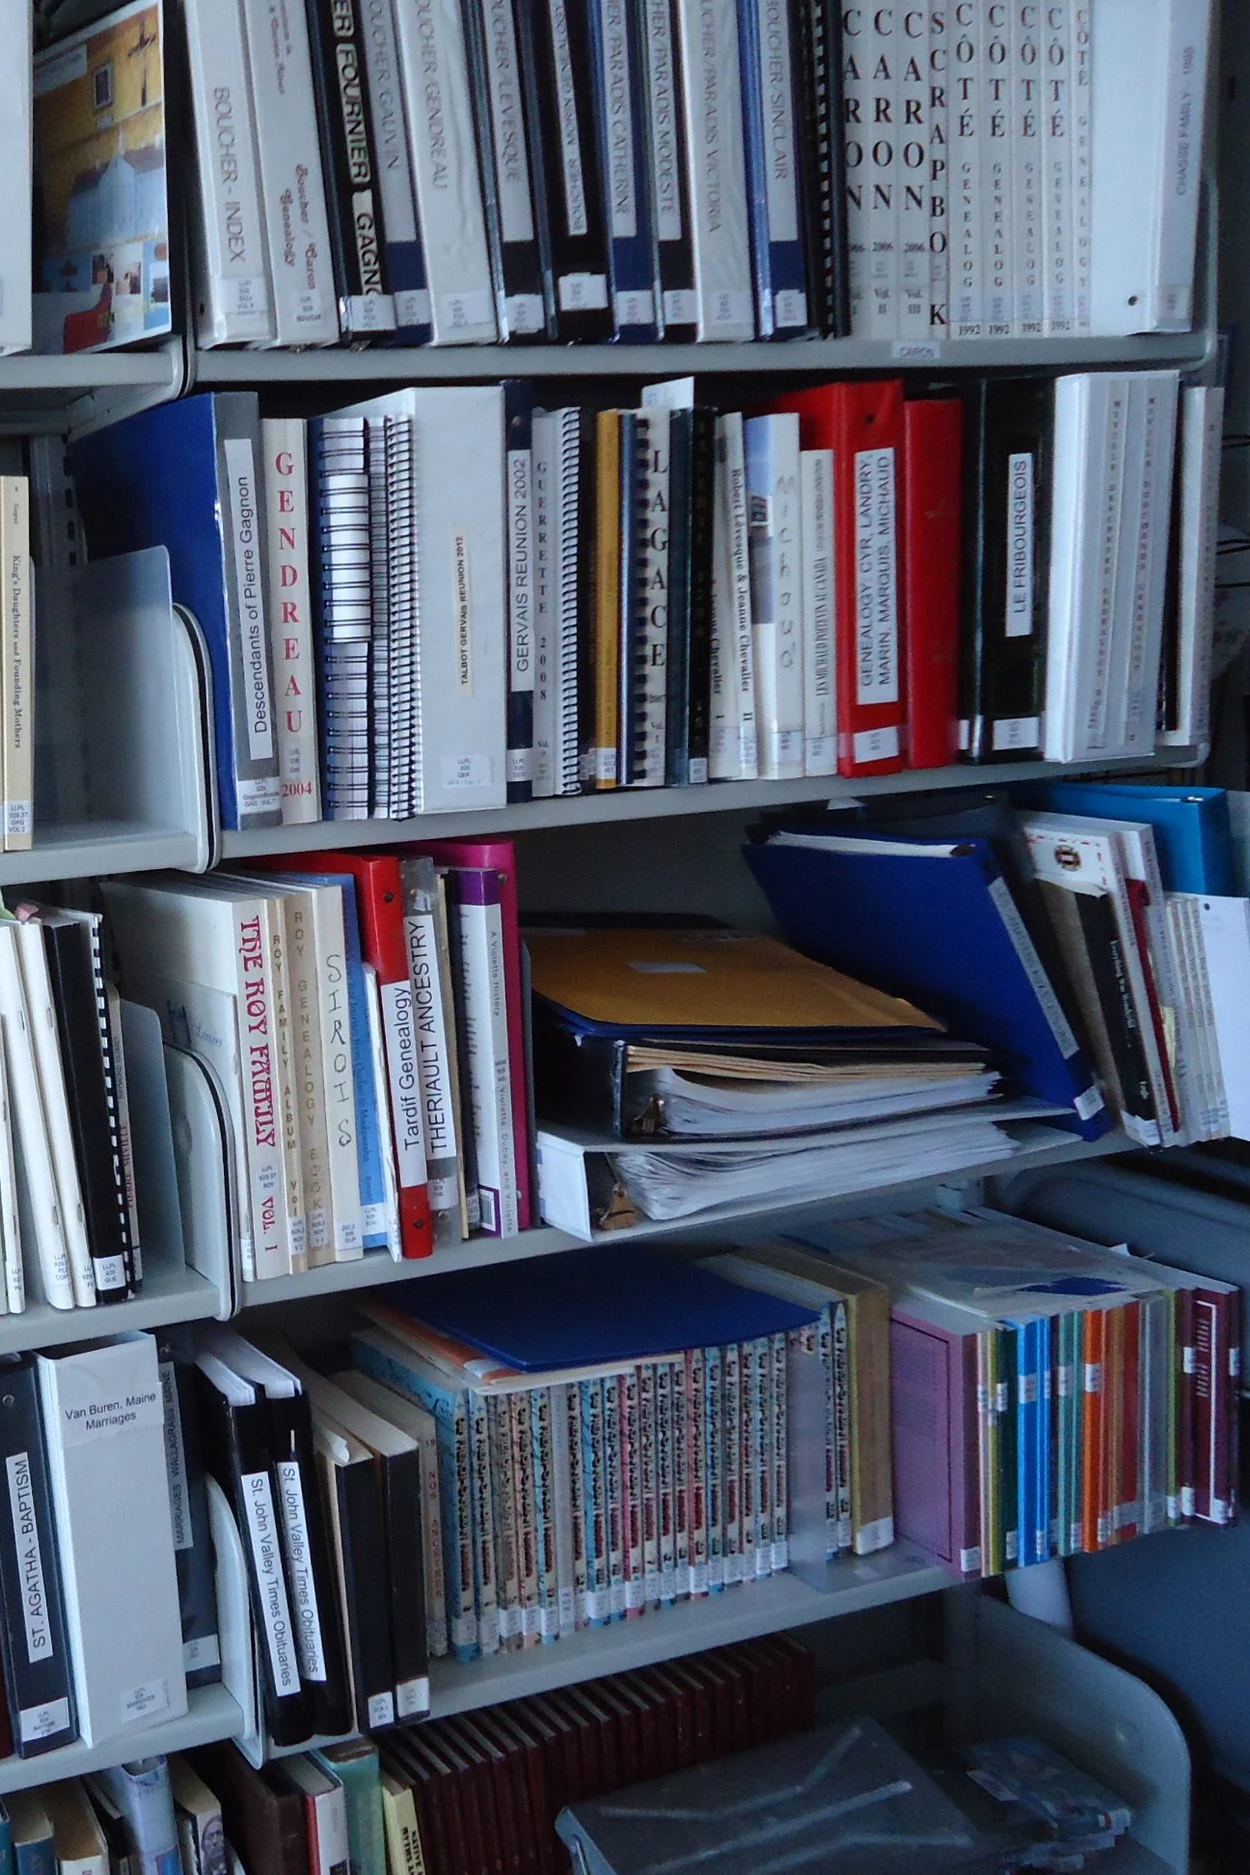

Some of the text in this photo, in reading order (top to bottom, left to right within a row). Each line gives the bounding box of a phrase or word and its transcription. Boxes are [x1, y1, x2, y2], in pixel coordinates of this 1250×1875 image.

[213, 87, 246, 264] BOUCHER INDEX
[337, 46, 370, 180] FOURNIER
[424, 83, 449, 190] GENDREAU
[903, 11, 924, 210] CARON
[1179, 92, 1192, 142] FAMILY
[279, 188, 297, 269] Genealogy
[958, 323, 981, 335] 1992
[988, 323, 1010, 335] 1992
[514, 459, 528, 672] GERVAIS REUNION 2002
[650, 449, 669, 666] LAGACE
[876, 457, 890, 535] MICHAUD
[1012, 459, 1026, 612] LE FRIBOURGEOIS
[238, 477, 267, 734] Descendants of Pierre Gagnon
[275, 452, 303, 734] GENDREAU
[458, 559, 466, 602] REUNION
[281, 782, 312, 797] 2004
[240, 916, 276, 1146] THE ROY FAMILY
[294, 912, 316, 1128] ROY GENEALOGY
[325, 954, 352, 1147] SIROIS
[391, 986, 419, 1151] Tardif Genealogy
[408, 922, 446, 1154] THERIAULT ANCESTRY
[65, 1406, 86, 1420] Van
[126, 1392, 156, 1407] Maine
[86, 1410, 137, 1431] Marriages
[14, 1460, 36, 1535] BAPTISM
[283, 1468, 318, 1673] St. John Valley Times Obituaries
[26, 1550, 44, 1618] AGATHA
[251, 1478, 291, 1687] St. John Valley Times Obituaries
